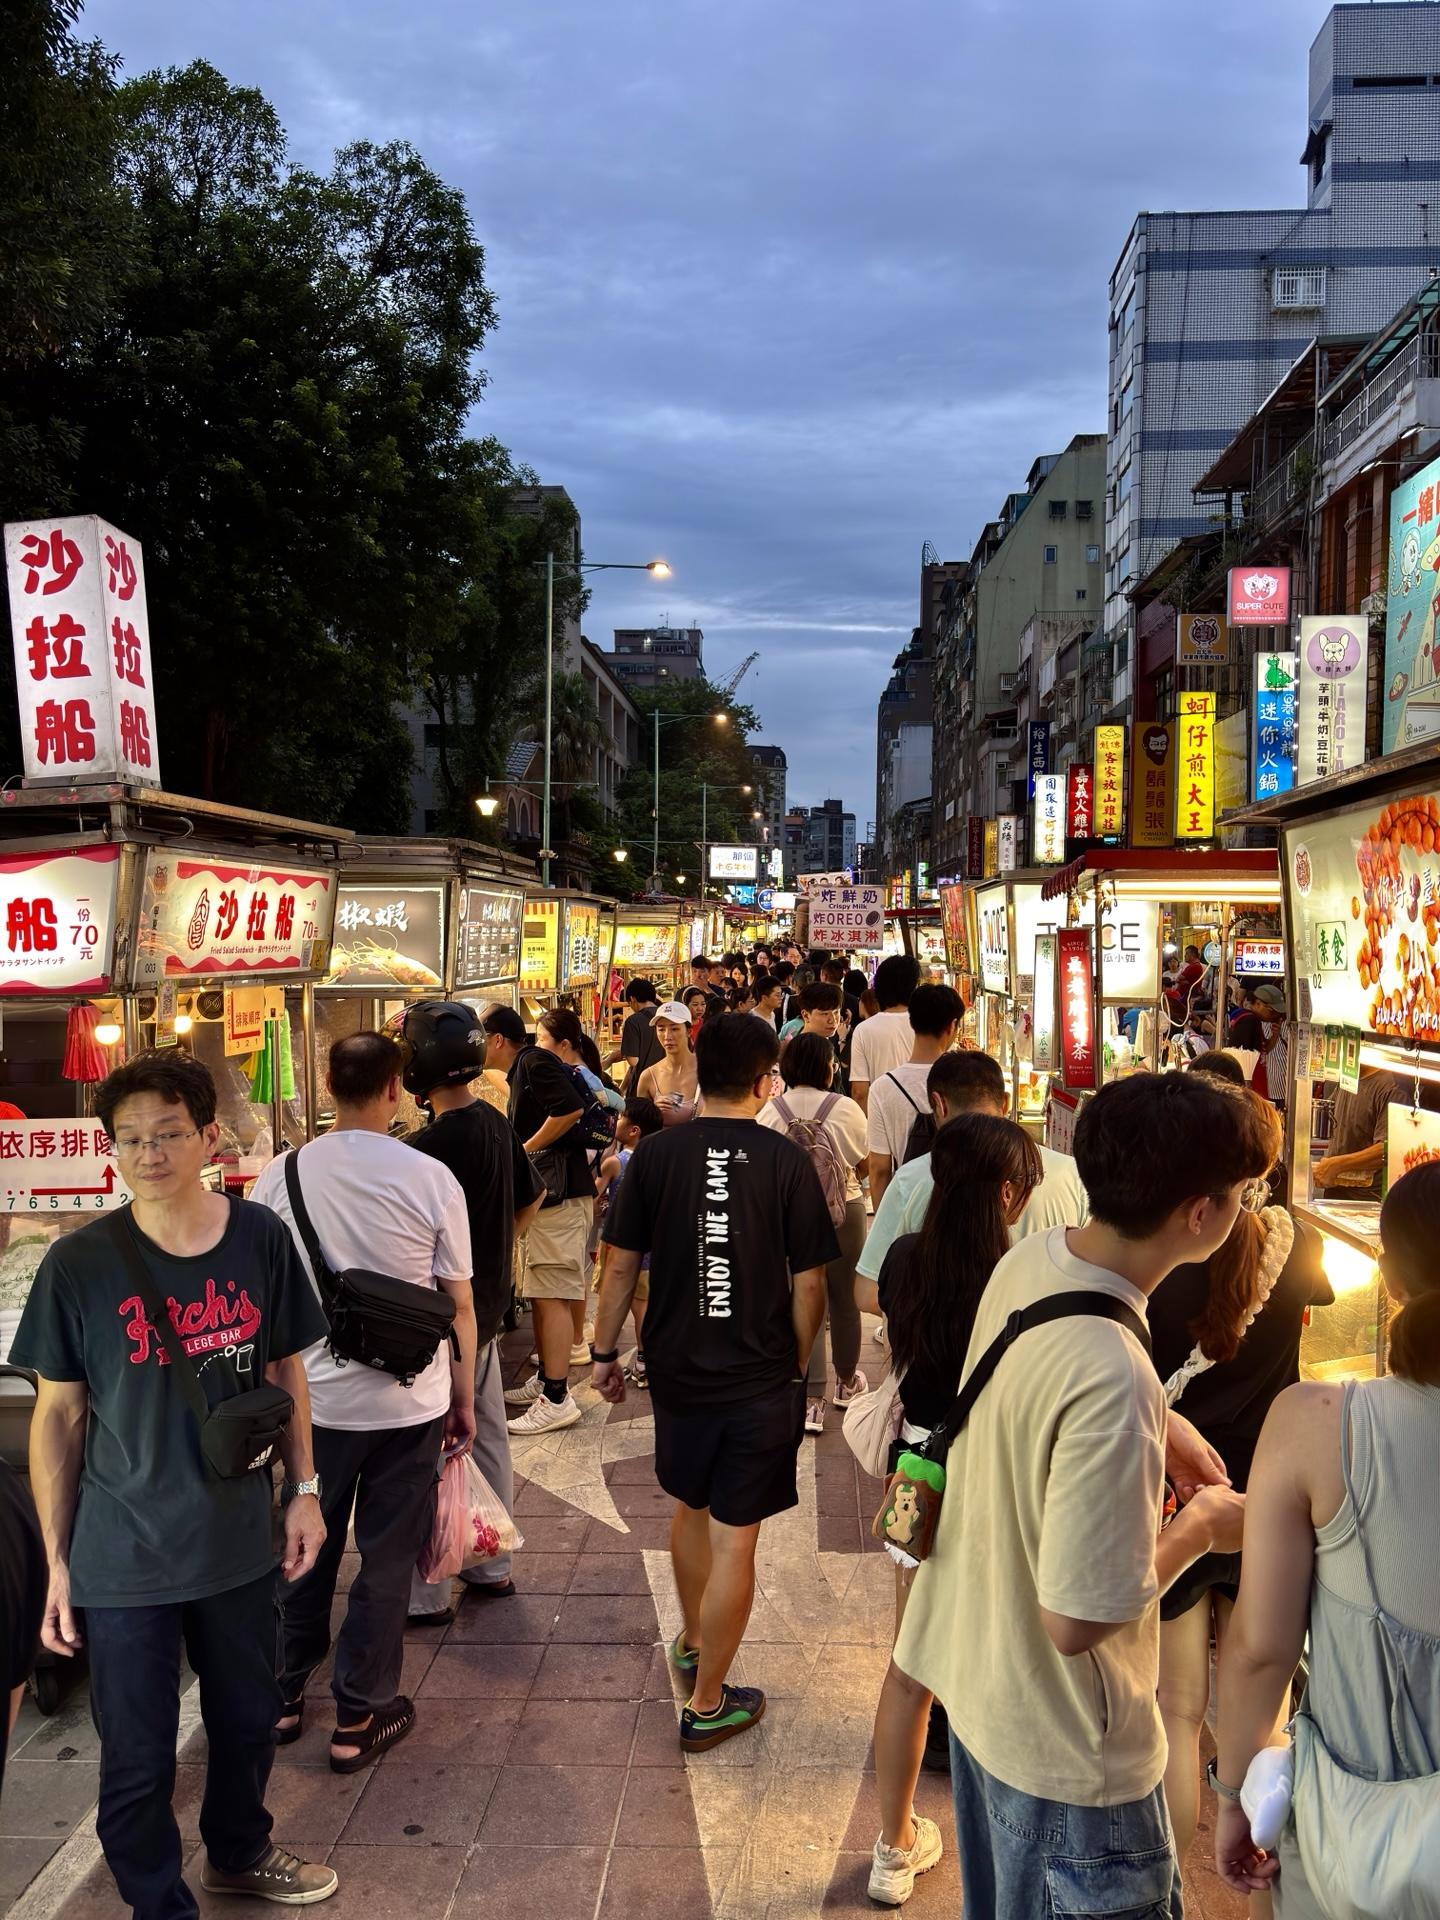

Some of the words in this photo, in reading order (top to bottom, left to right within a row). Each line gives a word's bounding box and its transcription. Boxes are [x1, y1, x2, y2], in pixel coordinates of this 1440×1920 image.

[1402, 482, 1440, 527] 一緒
[1236, 602, 1262, 610] SUPER
[1263, 602, 1284, 610] CUTE
[20, 529, 96, 766] 沙拉船
[105, 535, 151, 768] 沙拉船
[1334, 683, 1347, 740] TARO
[1032, 727, 1047, 798] 裕生西
[1186, 697, 1210, 832] 蚵仔煎大王
[1258, 703, 1281, 792] 迷你火鍋
[1073, 768, 1089, 838] 嘉義火雞肉
[1102, 752, 1118, 831] 客家放山雞莊
[1145, 769, 1166, 829] 鬍鬚張
[214, 889, 295, 941] 沙拉船
[813, 912, 863, 926] 炸OREO
[821, 889, 877, 904] 炸鮮奶
[6, 897, 58, 952] 船
[813, 929, 879, 943] 炸冰淇淋
[1037, 922, 1140, 951] TCE
[1318, 928, 1345, 966] 素食
[210, 946, 222, 954] Fried
[1245, 960, 1280, 970] 炒米粉
[1312, 974, 1322, 989] 02
[1376, 1003, 1408, 1027] sweet
[1413, 1002, 1440, 1034] pota
[705, 1147, 731, 1202] GAME
[7, 1197, 15, 1210] 7
[29, 1196, 37, 1209] 6
[50, 1195, 58, 1208] 5
[73, 1195, 82, 1208] 4
[95, 1195, 104, 1207] 3
[705, 1210, 729, 1244] THE
[706, 1255, 732, 1318] ENJOY
[220, 1328, 241, 1344] BAR
